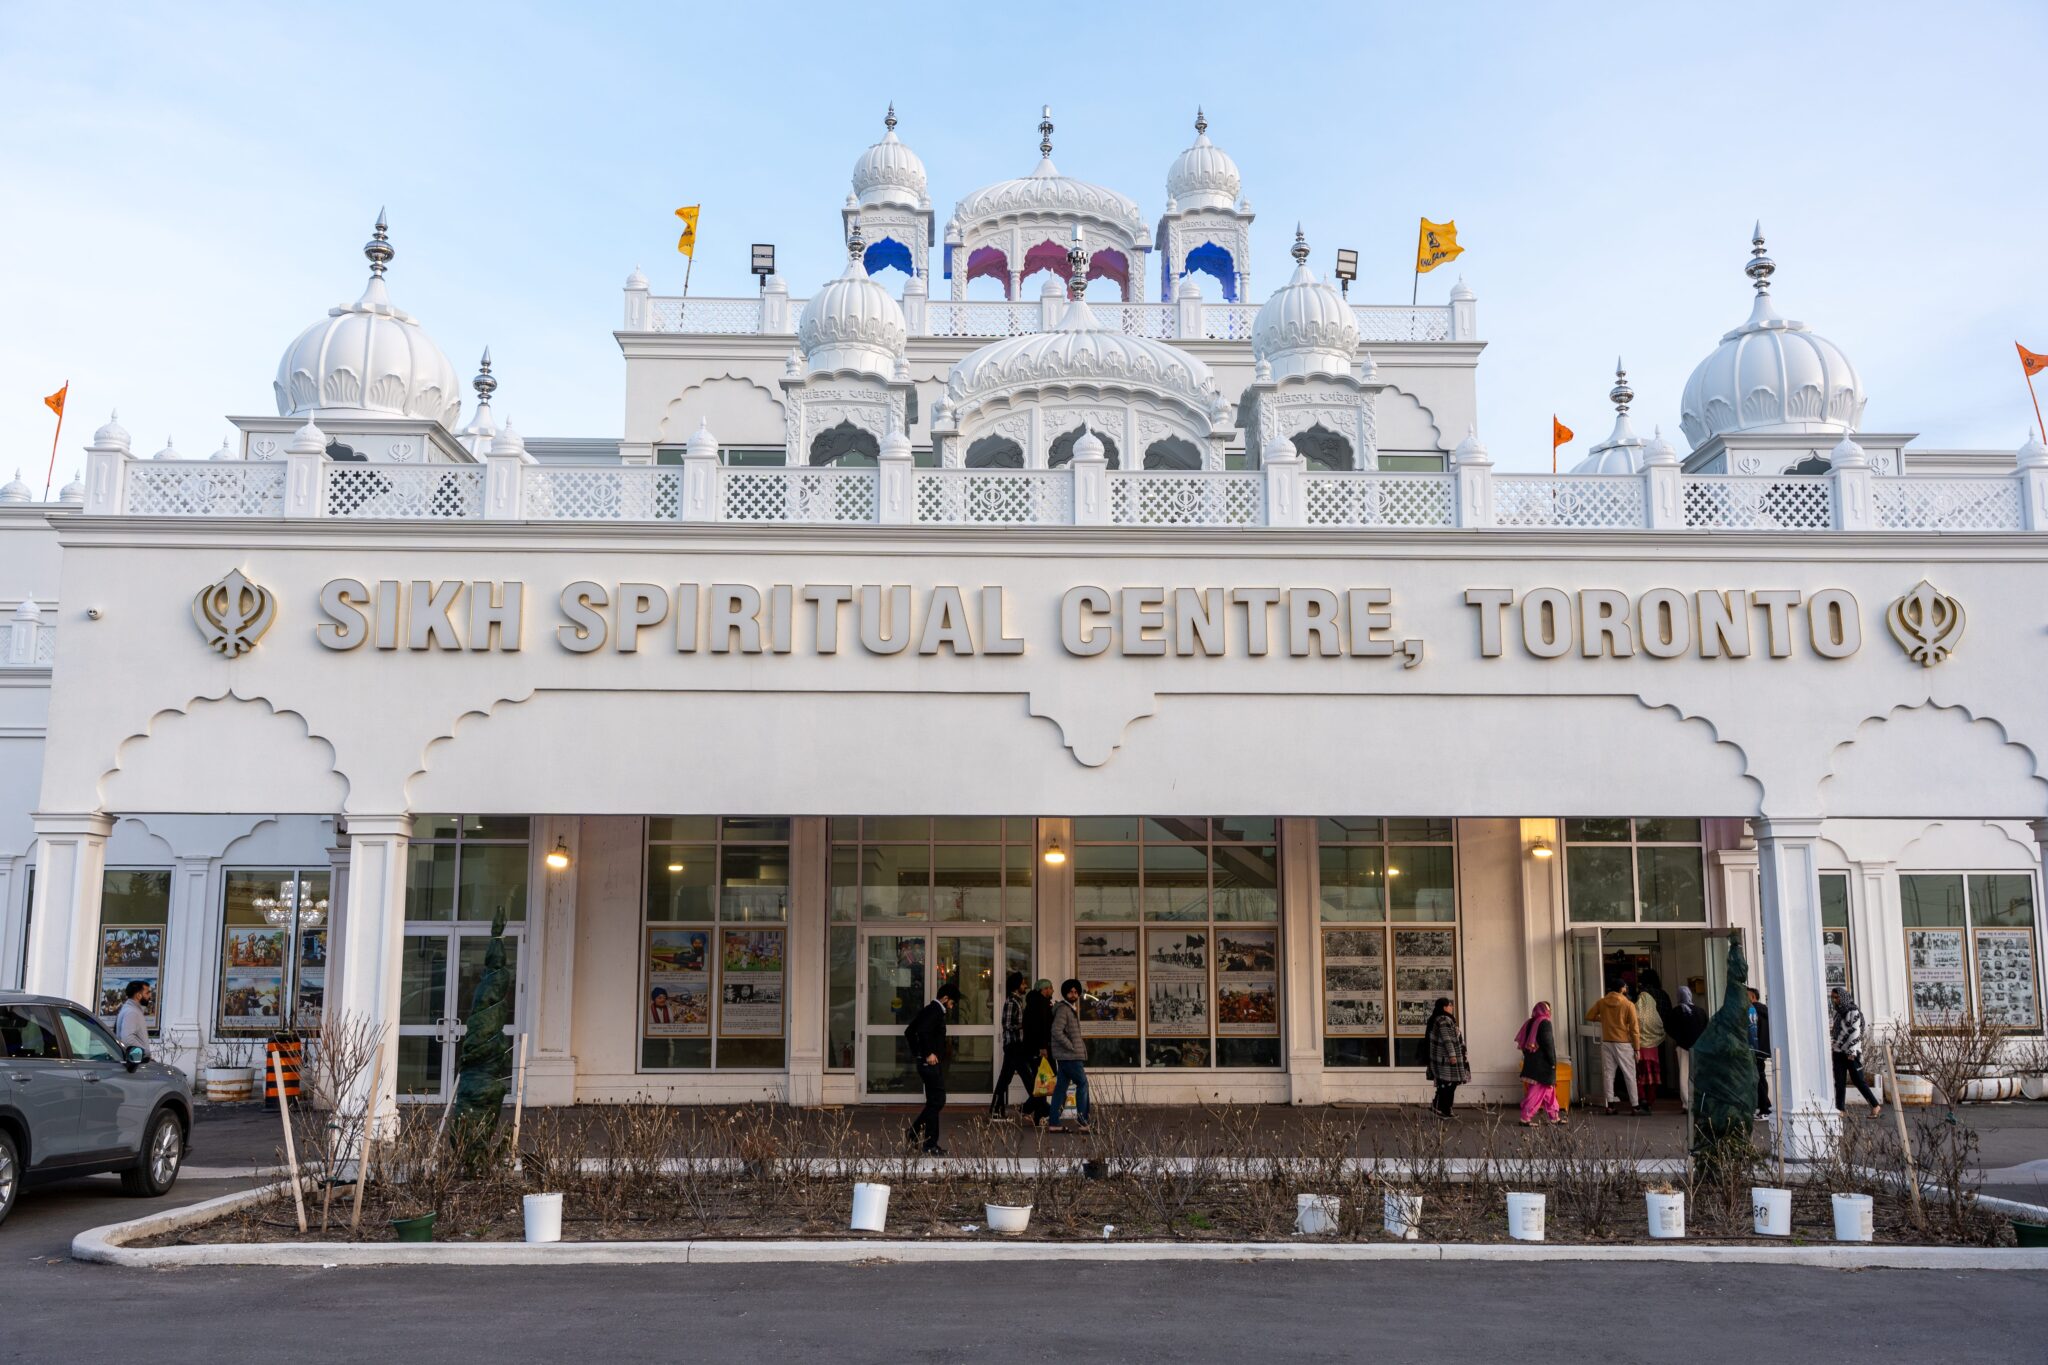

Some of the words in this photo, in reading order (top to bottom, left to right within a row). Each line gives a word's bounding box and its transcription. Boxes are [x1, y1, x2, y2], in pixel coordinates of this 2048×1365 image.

[316, 577, 524, 651] SIKH
[556, 580, 1025, 654] SPIRITUAL
[1061, 585, 1424, 668] CENTRE,
[1464, 587, 1862, 658] TORONTO
